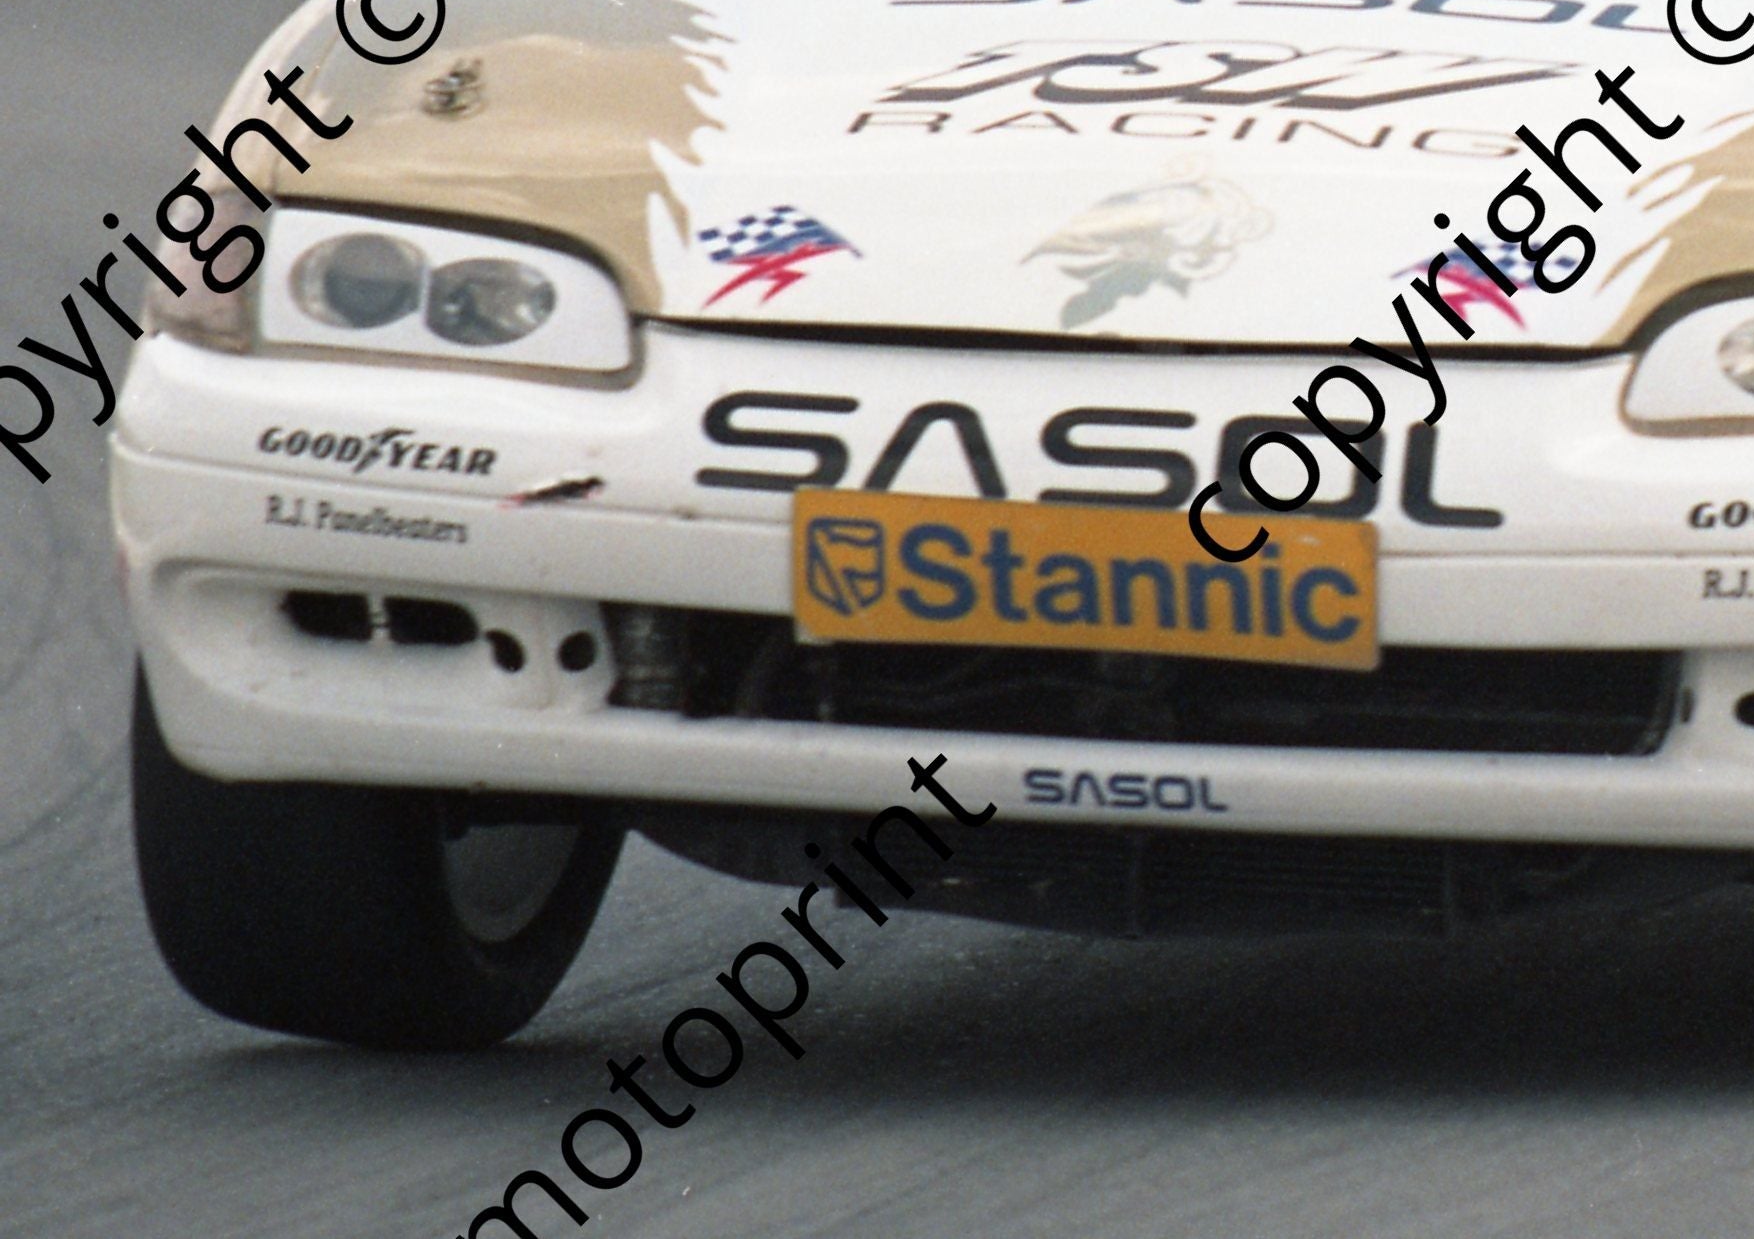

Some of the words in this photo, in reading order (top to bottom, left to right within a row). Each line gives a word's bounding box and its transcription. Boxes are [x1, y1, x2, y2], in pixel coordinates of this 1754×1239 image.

[848, 110, 1522, 158] RACING
[258, 426, 498, 476] GOODYEAR
[695, 390, 1504, 528] SASOL
[897, 524, 1361, 643] Stannic
[1703, 569, 1754, 599] R.J.
[1023, 768, 1230, 812] SASOL
